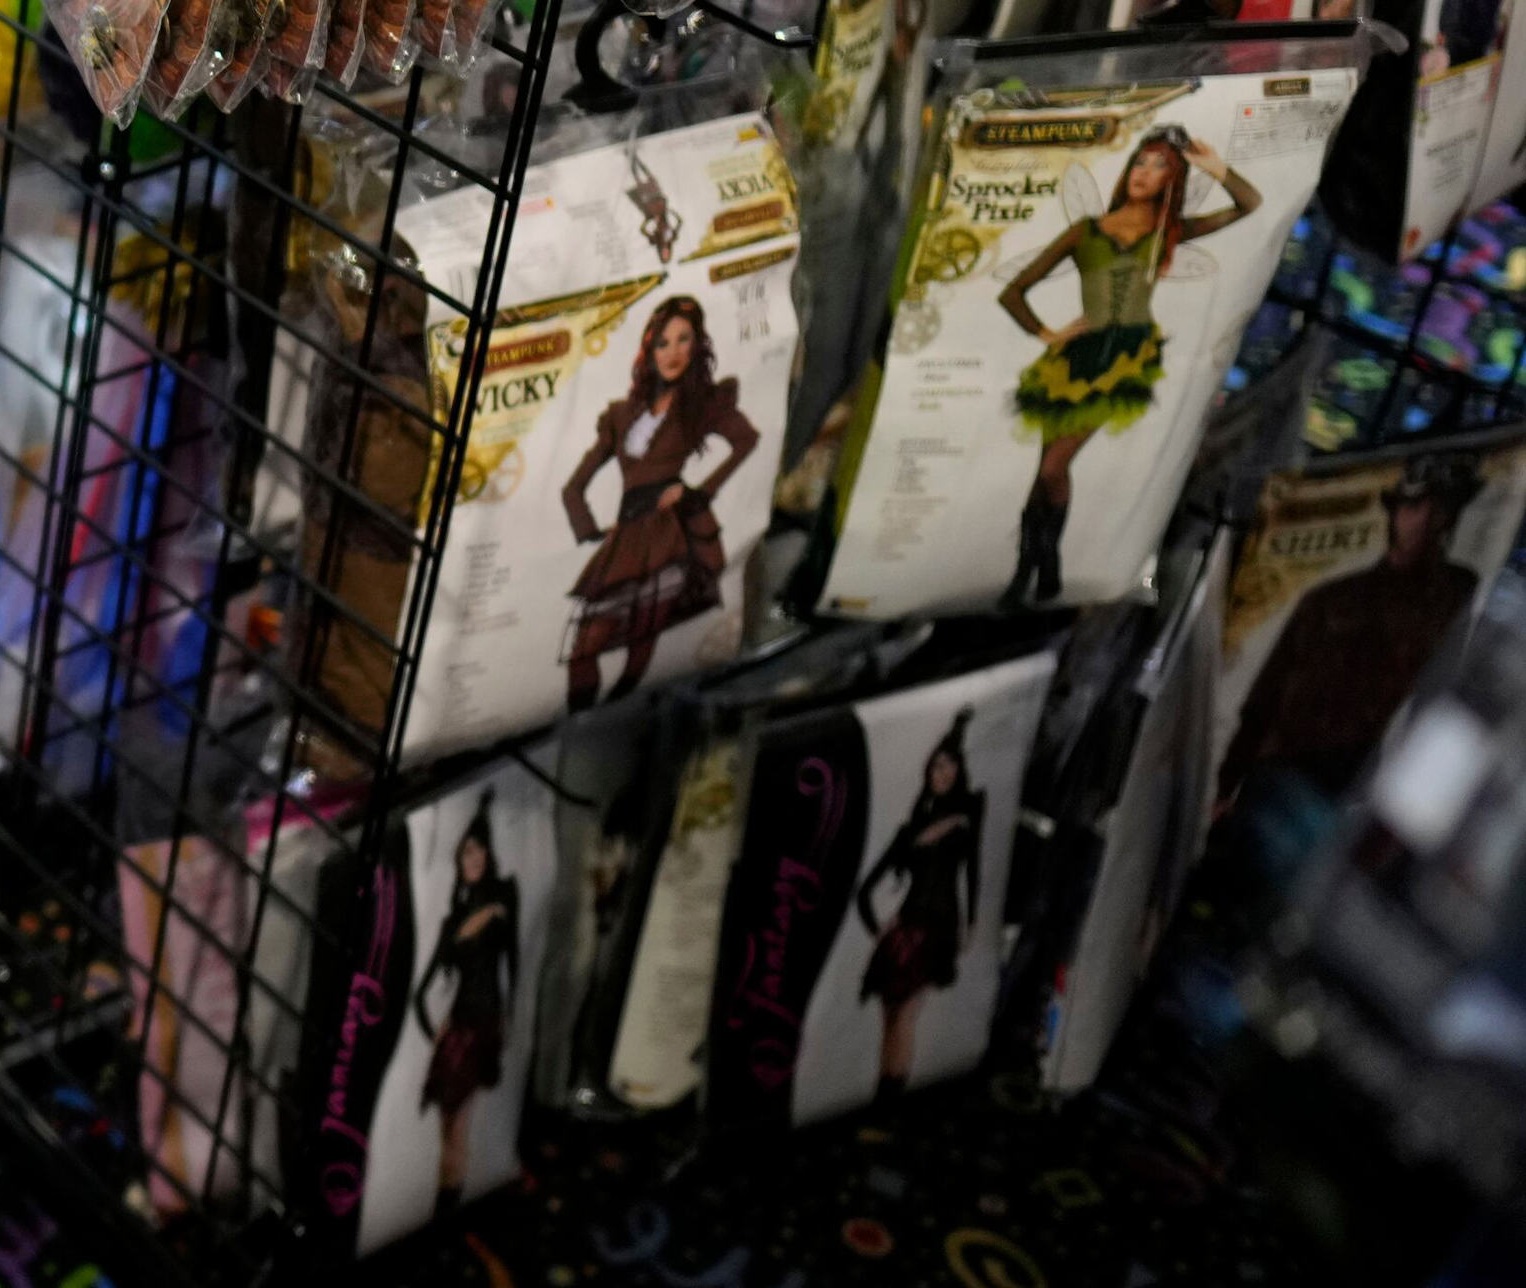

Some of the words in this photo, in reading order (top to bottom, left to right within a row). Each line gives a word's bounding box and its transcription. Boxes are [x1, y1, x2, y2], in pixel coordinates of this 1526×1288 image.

[986, 122, 1096, 140] STEAMPUNK
[950, 173, 1059, 204] Sprocket
[972, 201, 1035, 221] Pixie
[481, 338, 556, 367] TEAMPUNK
[474, 369, 562, 415] VICKY
